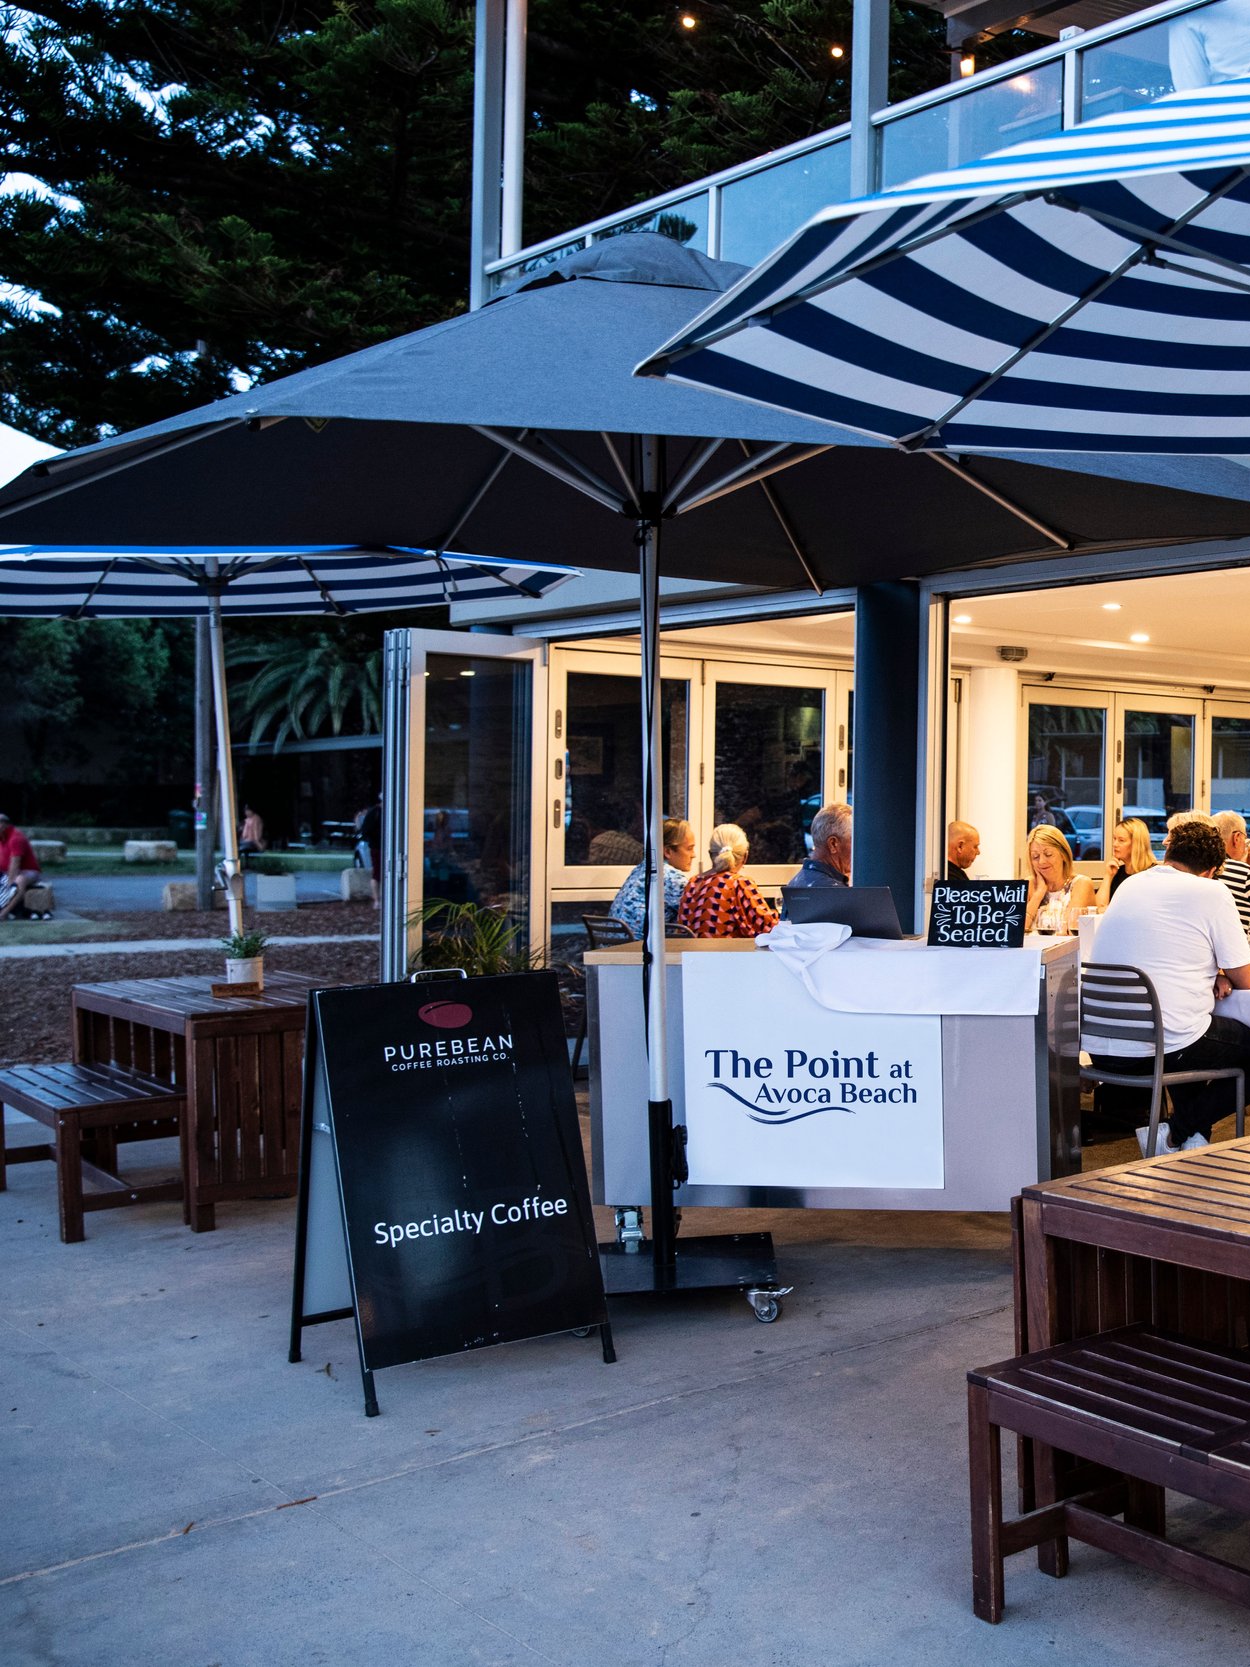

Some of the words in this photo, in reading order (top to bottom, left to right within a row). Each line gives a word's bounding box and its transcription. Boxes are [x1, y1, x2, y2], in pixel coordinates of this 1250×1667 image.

[934, 887, 991, 903] Please
[992, 885, 1026, 903] Wait
[952, 906, 976, 925] To
[977, 905, 1004, 924] Be
[938, 924, 1009, 943] Seated
[384, 1034, 513, 1062] PUREBEAN
[391, 1060, 433, 1072] COFFEE
[436, 1054, 489, 1067] ROASTING
[493, 1052, 510, 1061] CO.
[704, 1049, 773, 1079] The
[784, 1050, 880, 1079] Point
[889, 1060, 914, 1079] at
[754, 1082, 831, 1104] Avoca
[839, 1082, 917, 1104] Beach
[374, 1209, 484, 1248] Specialty
[491, 1196, 568, 1225] Coffee
